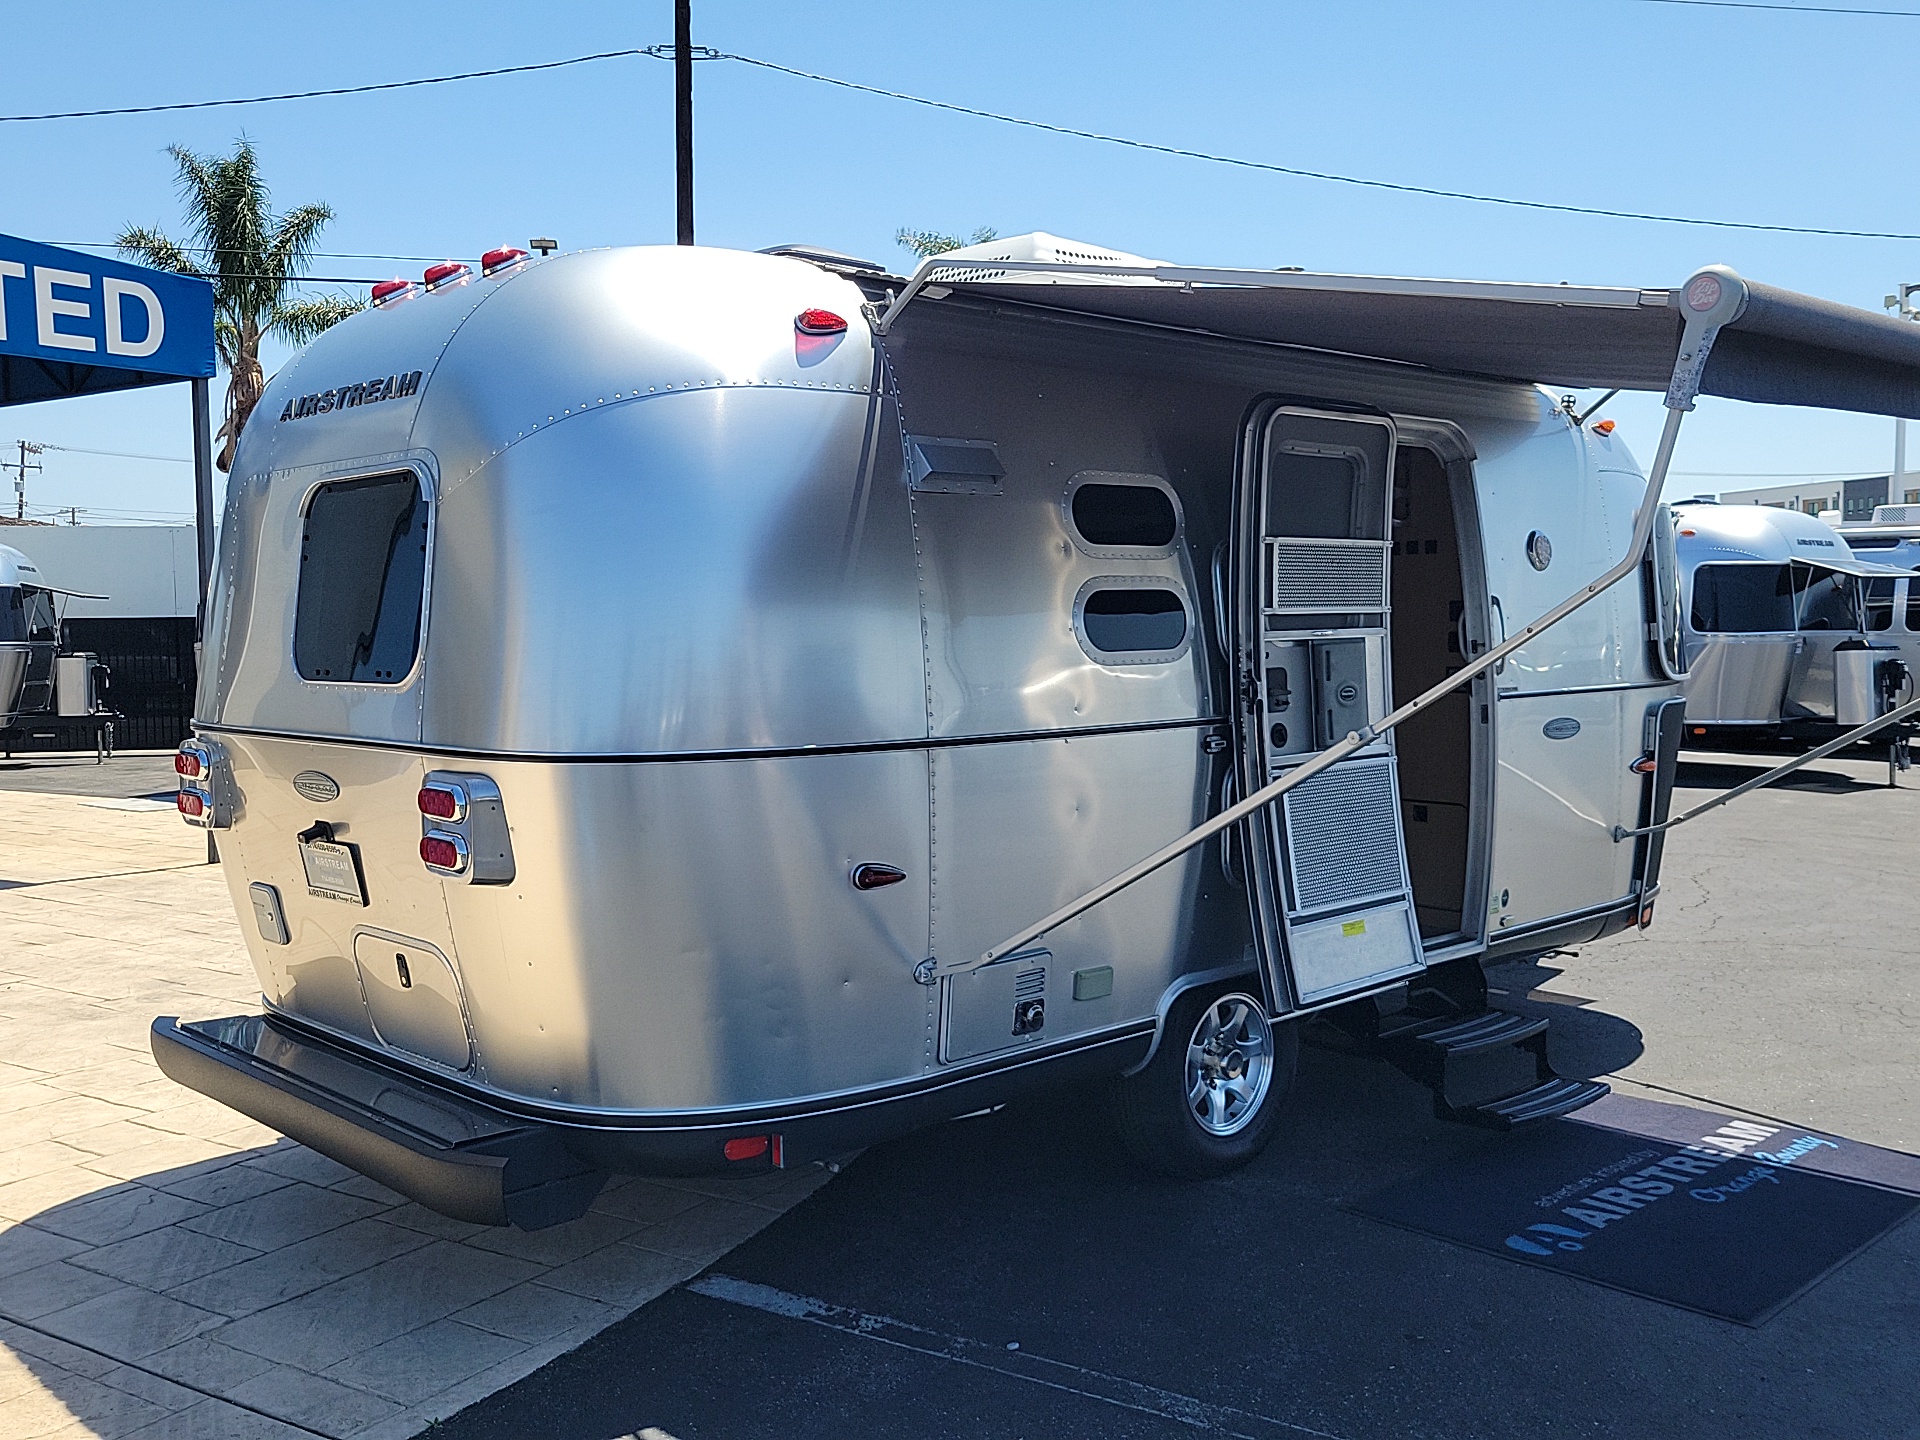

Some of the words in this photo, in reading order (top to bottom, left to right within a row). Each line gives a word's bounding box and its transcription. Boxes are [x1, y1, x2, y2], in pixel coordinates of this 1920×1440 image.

[279, 369, 423, 422] AIRSTREAM
[315, 857, 349, 871] AIRSTREAM
[308, 888, 337, 900] AIRSTREAM
[1561, 1119, 1781, 1229] AIRSTREAM
[1689, 1166, 1780, 1203] Orange
[1753, 1135, 1839, 1168] County
